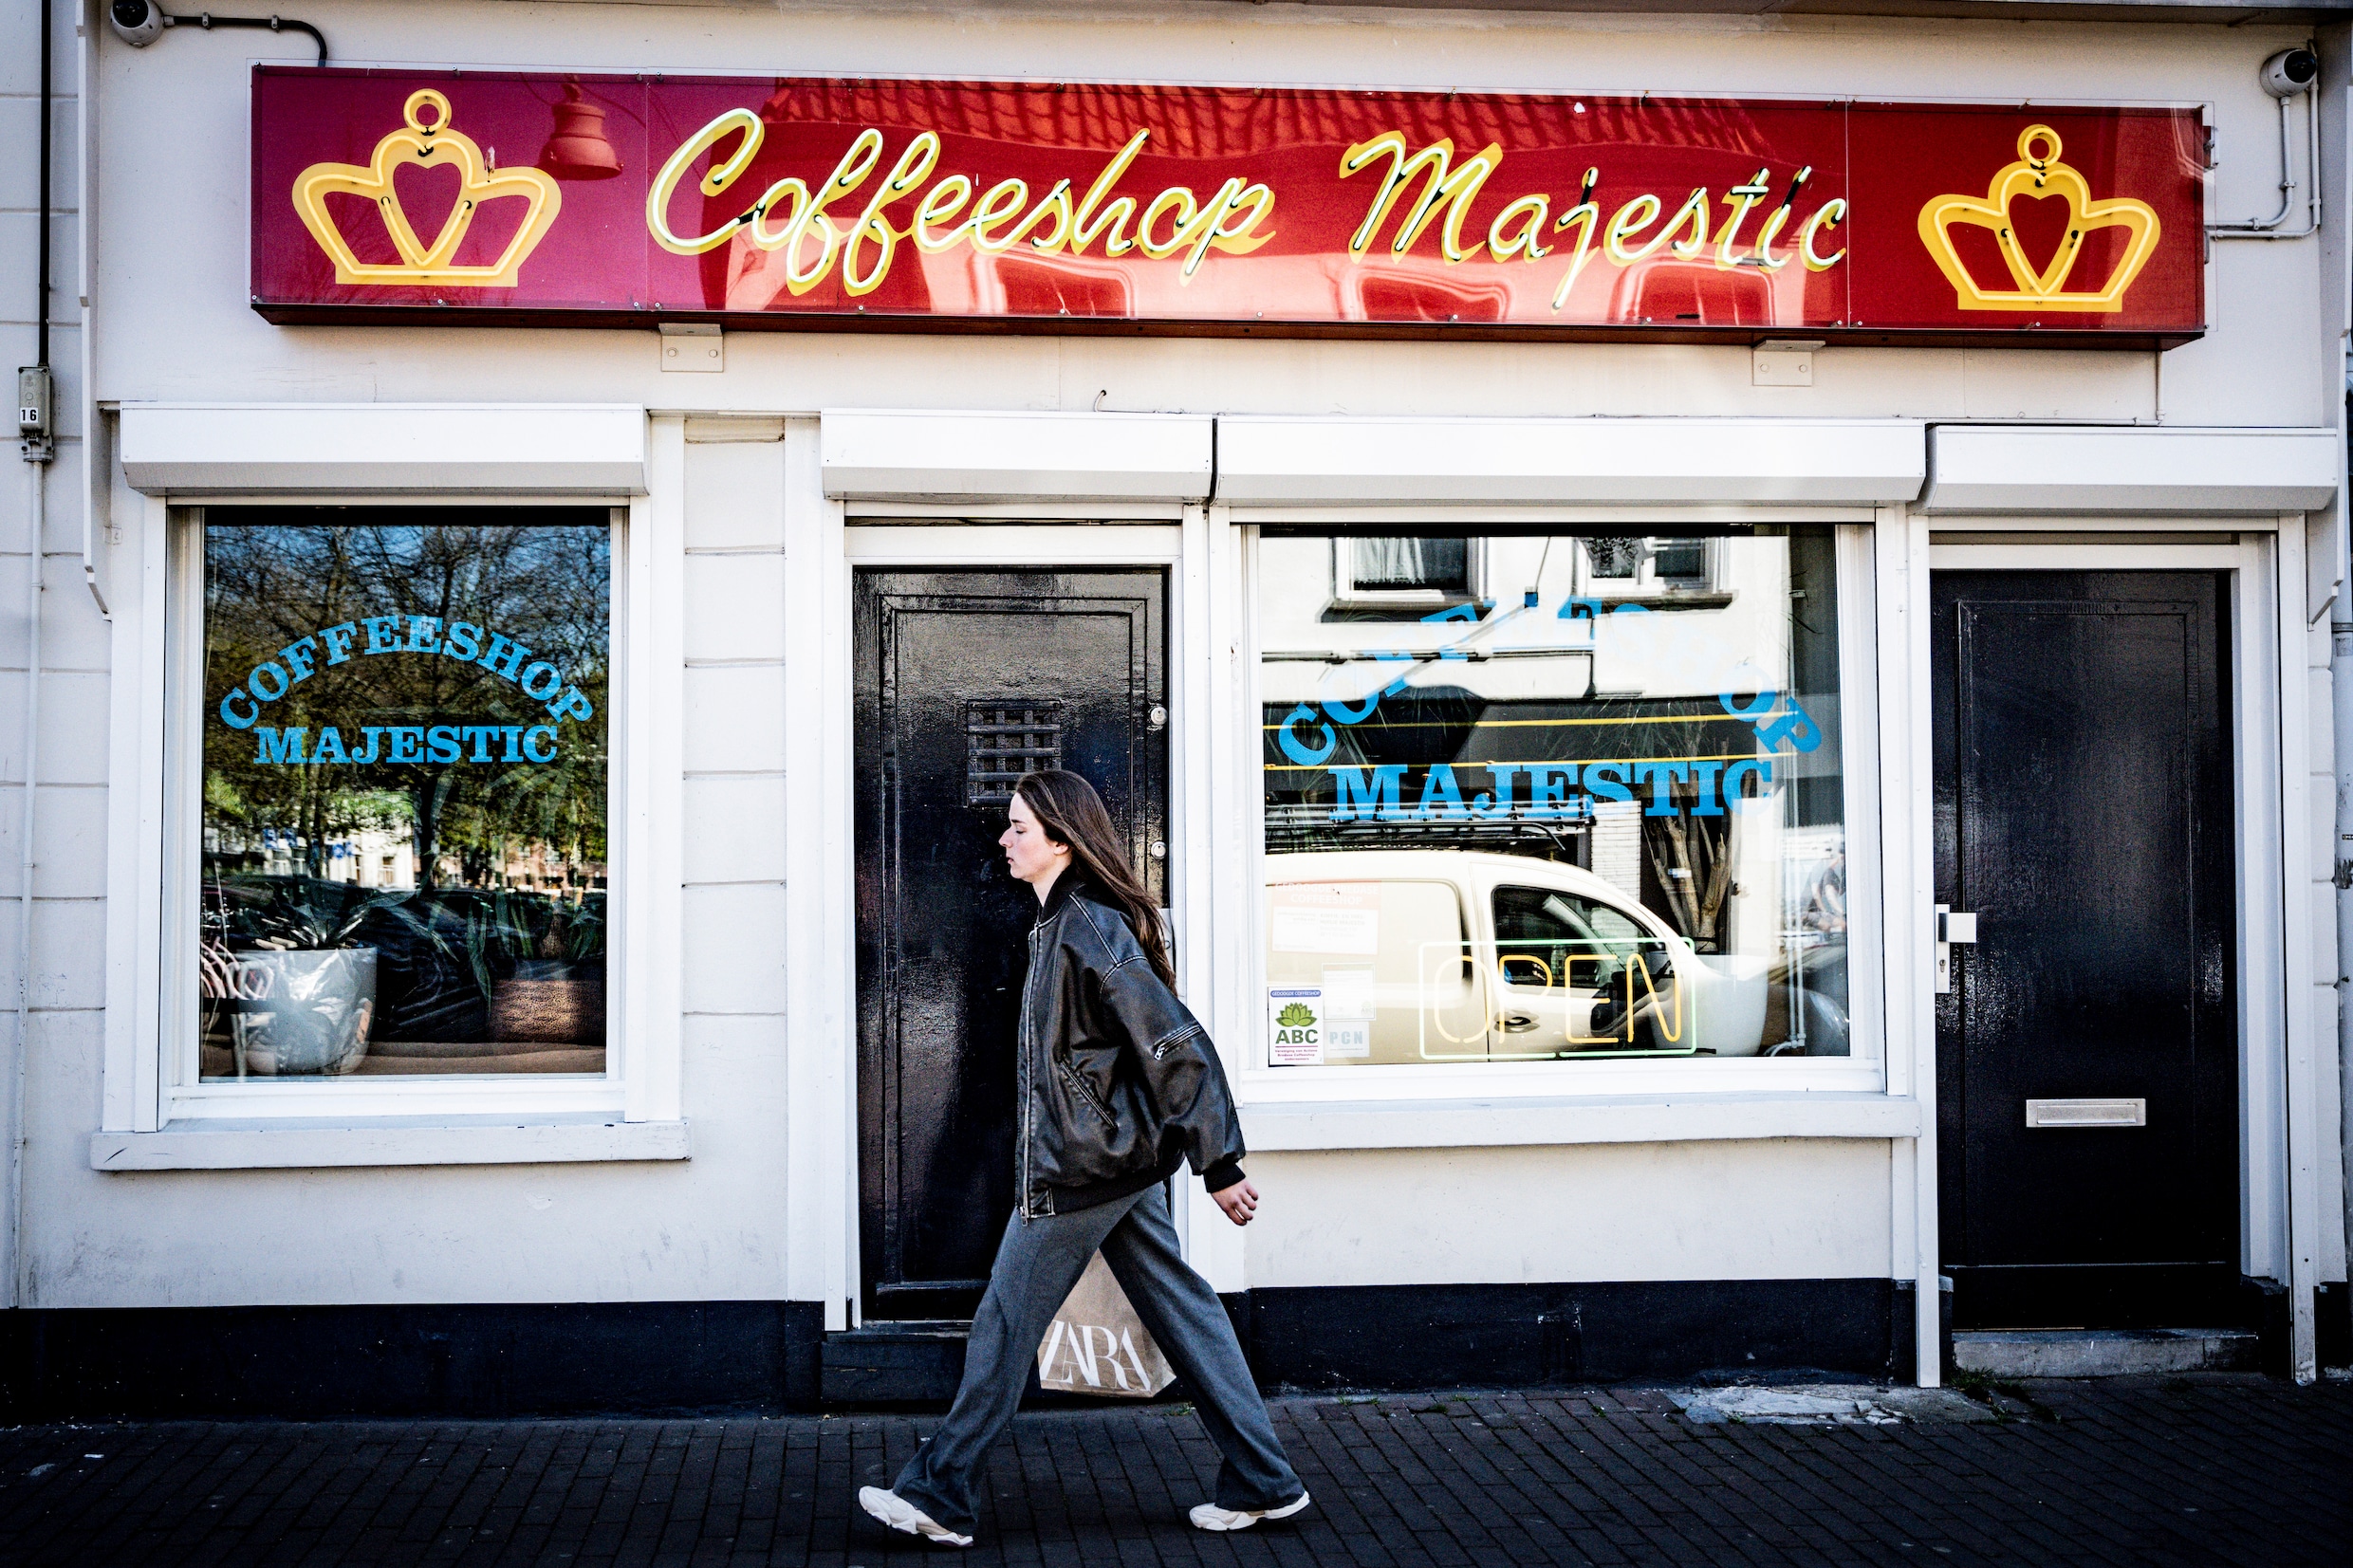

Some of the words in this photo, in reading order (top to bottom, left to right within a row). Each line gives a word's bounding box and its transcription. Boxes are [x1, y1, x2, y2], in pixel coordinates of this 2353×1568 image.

[646, 107, 1276, 296] Coffeeshop
[1339, 130, 1847, 315] Majestic
[21, 409, 37, 421] 16
[219, 615, 593, 729] COFFEESHOP
[1278, 593, 1822, 766] COFFEOP
[252, 725, 558, 765] MAJESTIC
[1328, 759, 1772, 821] MAJESTIC
[1434, 953, 1681, 1043] OPEN
[1275, 1028, 1318, 1043] ABC
[1329, 1030, 1363, 1044] PCN
[1039, 1319, 1152, 1392] ZARA
